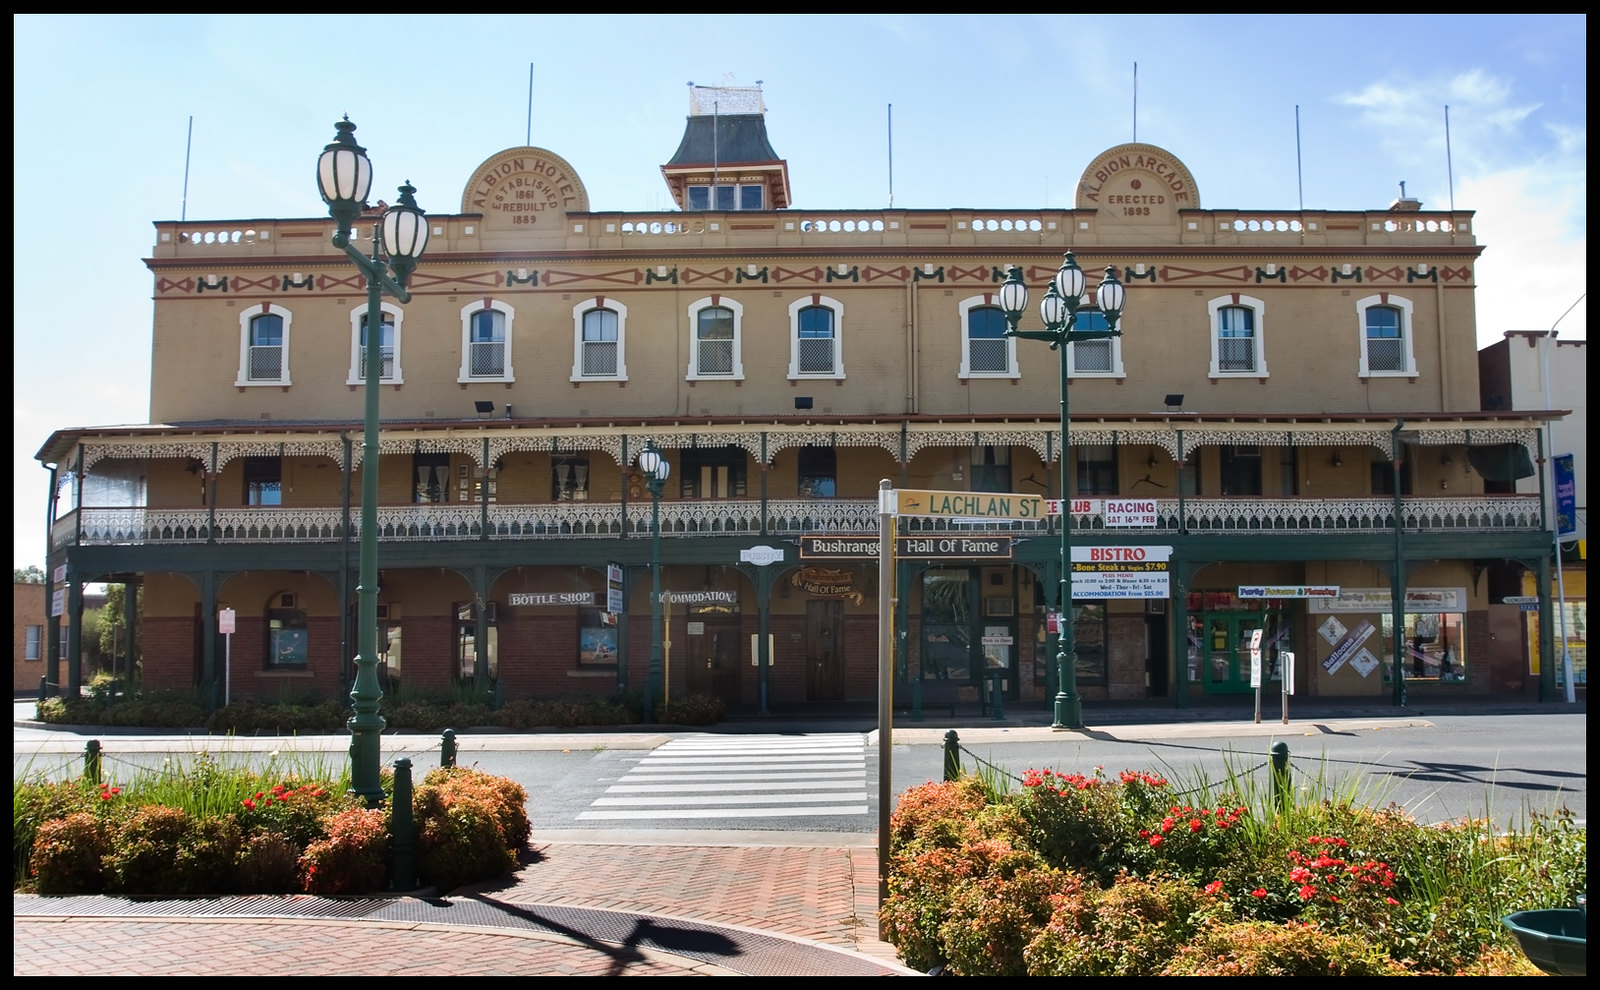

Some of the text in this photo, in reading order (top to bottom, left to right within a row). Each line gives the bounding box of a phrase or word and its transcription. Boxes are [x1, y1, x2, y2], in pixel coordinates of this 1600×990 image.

[473, 159, 575, 208] ALBION HOTEL
[1086, 155, 1188, 203] ALBION ARCADE
[492, 178, 558, 209] ESTABLISHED
[515, 190, 534, 199] 1861
[1108, 195, 1165, 204] ERECTED
[502, 202, 547, 212] REBUILT
[1123, 207, 1150, 216] 1893
[512, 215, 537, 224] 1889
[929, 495, 1011, 516] LACHLAN
[1019, 498, 1041, 518] ST
[1069, 501, 1091, 513] LUB
[1108, 502, 1155, 513] RACING
[1107, 516, 1121, 524] SAT
[1142, 516, 1155, 524] FEB
[812, 539, 998, 555] Bushrange Hall Of Fame
[1090, 548, 1145, 561] BISTRO
[1098, 563, 1119, 571] Steak
[1145, 562, 1167, 571] $7.90
[804, 583, 851, 594] Hall Of Fame
[512, 592, 590, 606] BOTTLE SHOP
